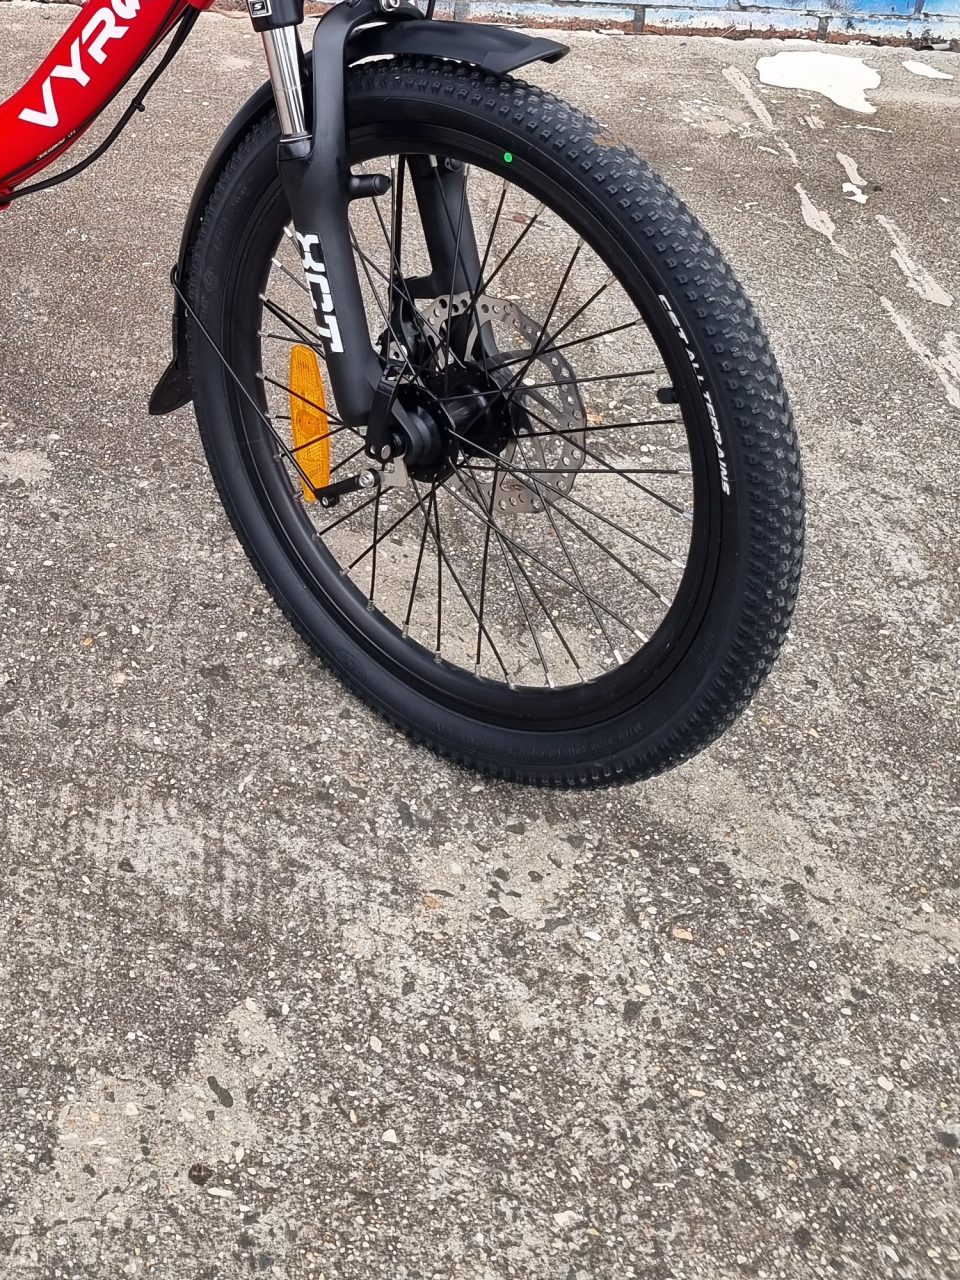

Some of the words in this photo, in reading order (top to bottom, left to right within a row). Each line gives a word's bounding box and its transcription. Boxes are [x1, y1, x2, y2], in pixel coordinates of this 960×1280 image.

[295, 230, 344, 353] XCT
[658, 294, 689, 344] CST
[685, 347, 705, 388] ALL
[702, 390, 731, 496] TERRAINS
